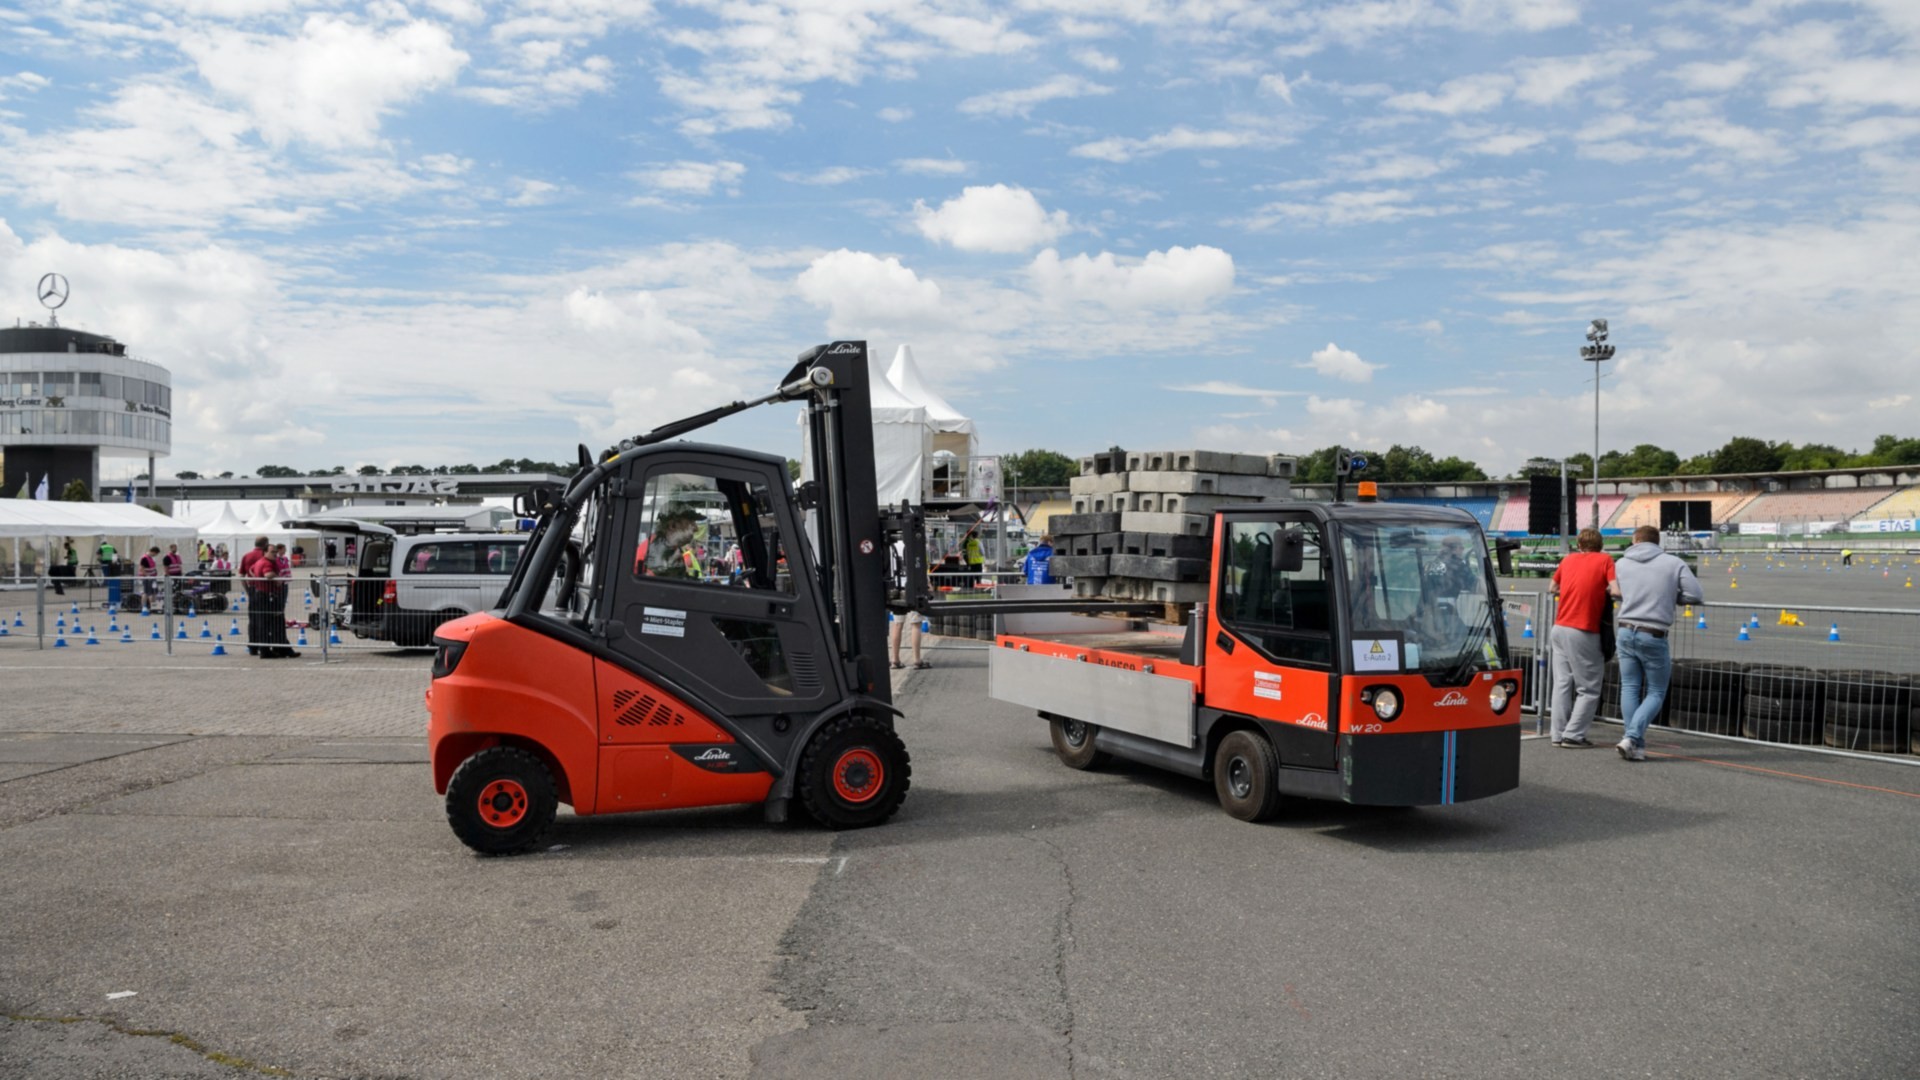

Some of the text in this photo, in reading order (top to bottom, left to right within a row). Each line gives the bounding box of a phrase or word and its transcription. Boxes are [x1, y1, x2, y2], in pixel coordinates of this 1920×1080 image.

[827, 343, 860, 354] Linde
[1879, 520, 1911, 532] ETAS
[1363, 653, 1392, 661] E-Auto 2
[1434, 691, 1468, 707] Linde
[1350, 724, 1382, 733] W 20
[694, 748, 731, 761] Linde
